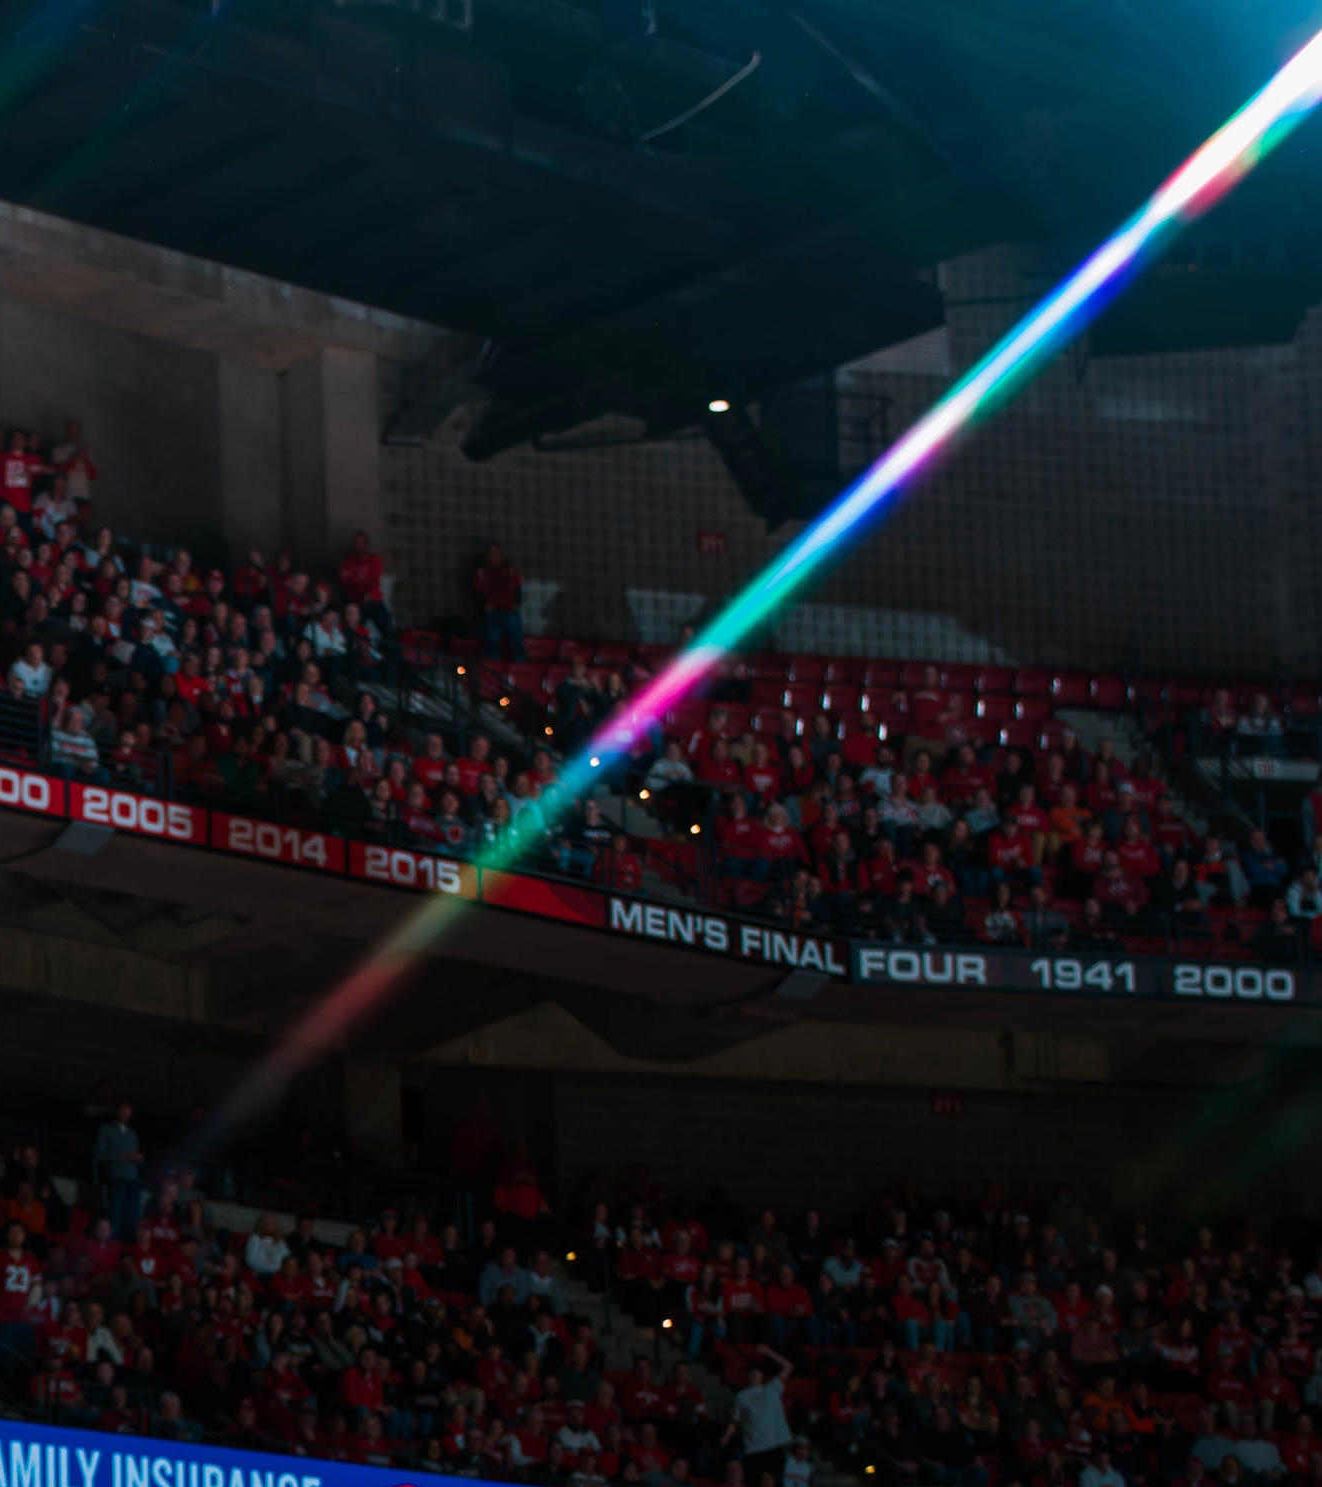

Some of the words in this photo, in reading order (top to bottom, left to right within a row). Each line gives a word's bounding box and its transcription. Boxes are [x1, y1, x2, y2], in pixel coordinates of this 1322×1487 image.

[82, 787, 193, 839] 2005
[228, 817, 328, 867] 2014
[364, 846, 461, 895] 2015
[610, 899, 730, 951] MEN'S
[740, 926, 845, 976] FINAL
[858, 948, 987, 986] FOUR
[1030, 957, 1136, 992] 1941
[1173, 964, 1294, 999] 2000
